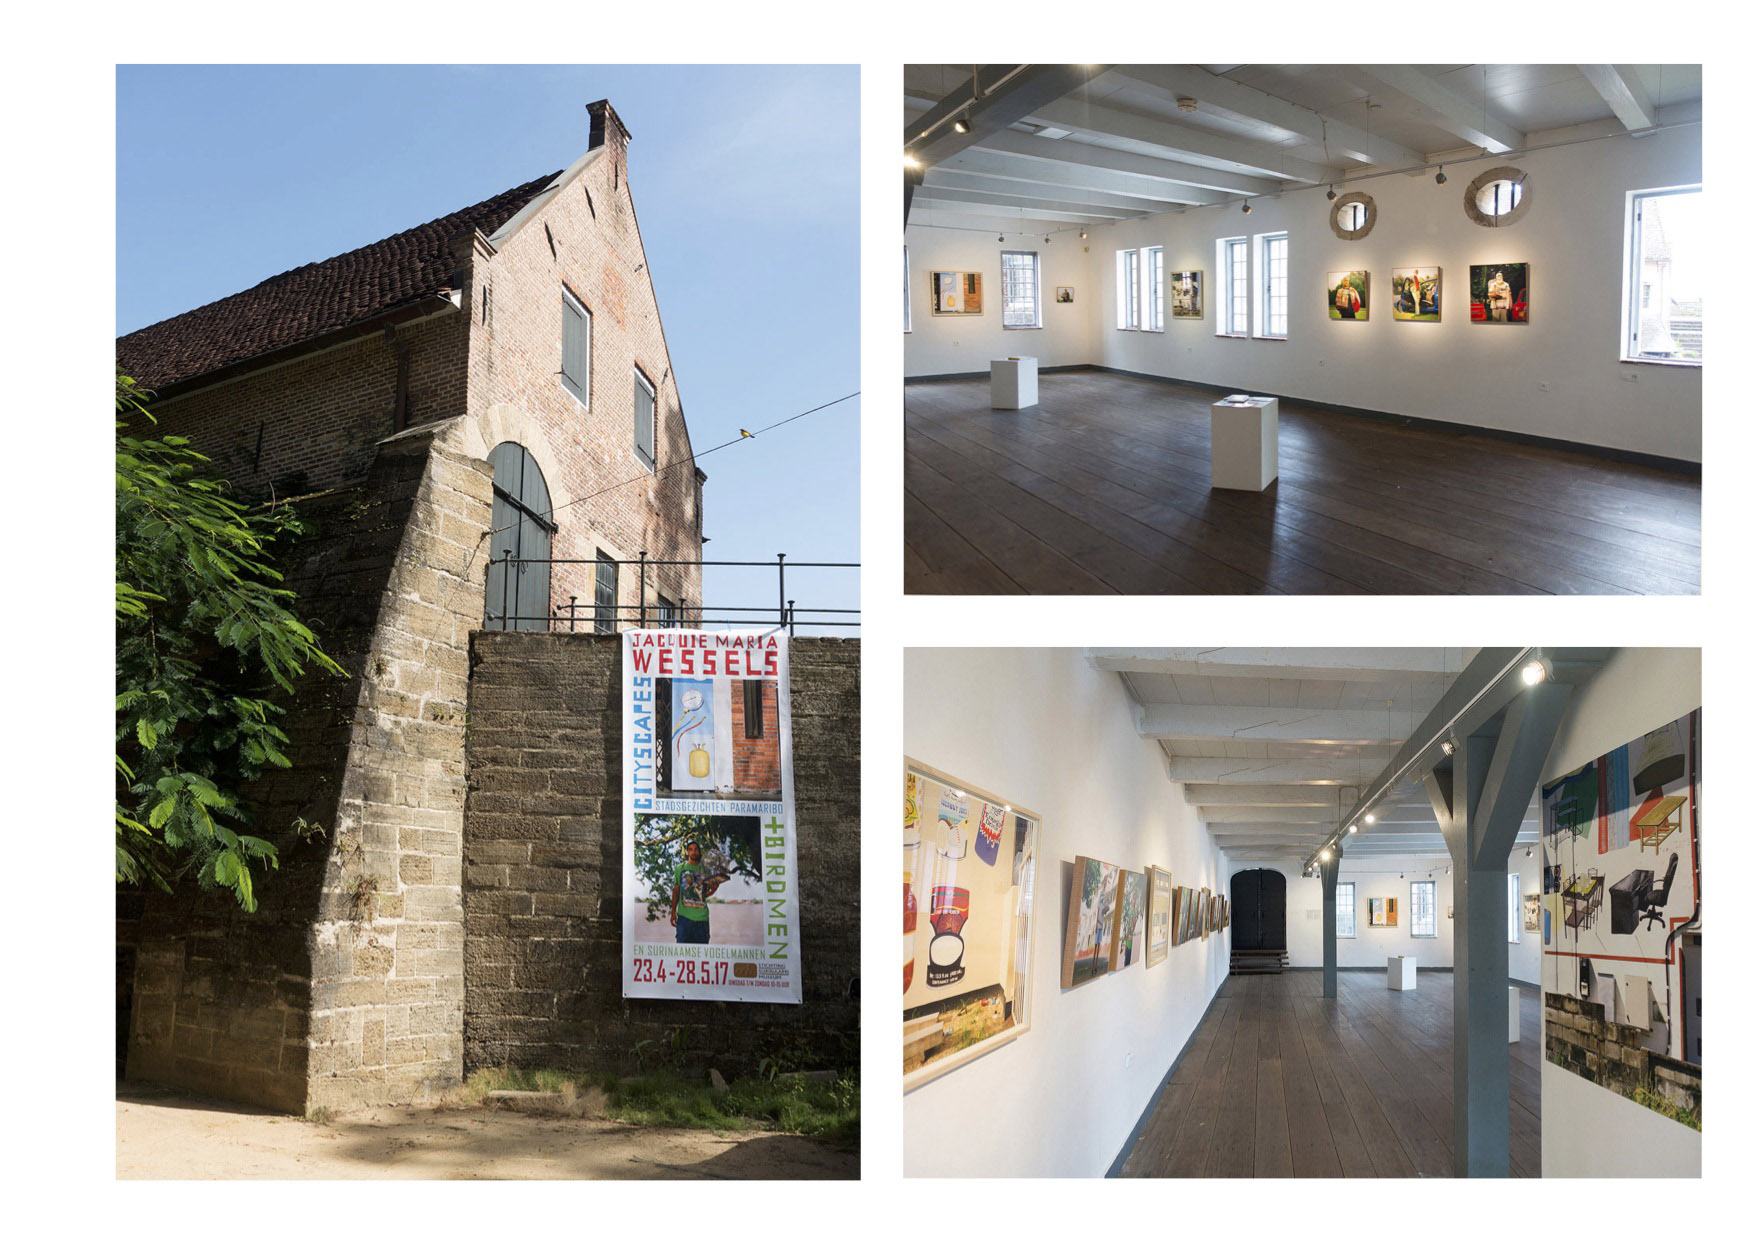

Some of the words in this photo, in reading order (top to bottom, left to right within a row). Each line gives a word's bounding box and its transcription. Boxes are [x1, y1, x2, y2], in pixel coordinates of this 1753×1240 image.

[716, 635, 778, 649] MARIA
[632, 649, 778, 676] WESSELS
[633, 676, 652, 809] CITYSCAPES
[655, 800, 726, 813] STADSGEZICHTEN
[730, 802, 783, 814] PARAMARIBO
[633, 944, 644, 956] EN
[647, 945, 701, 958] SURINAAMSE
[704, 947, 766, 960] VOGELMANNEN
